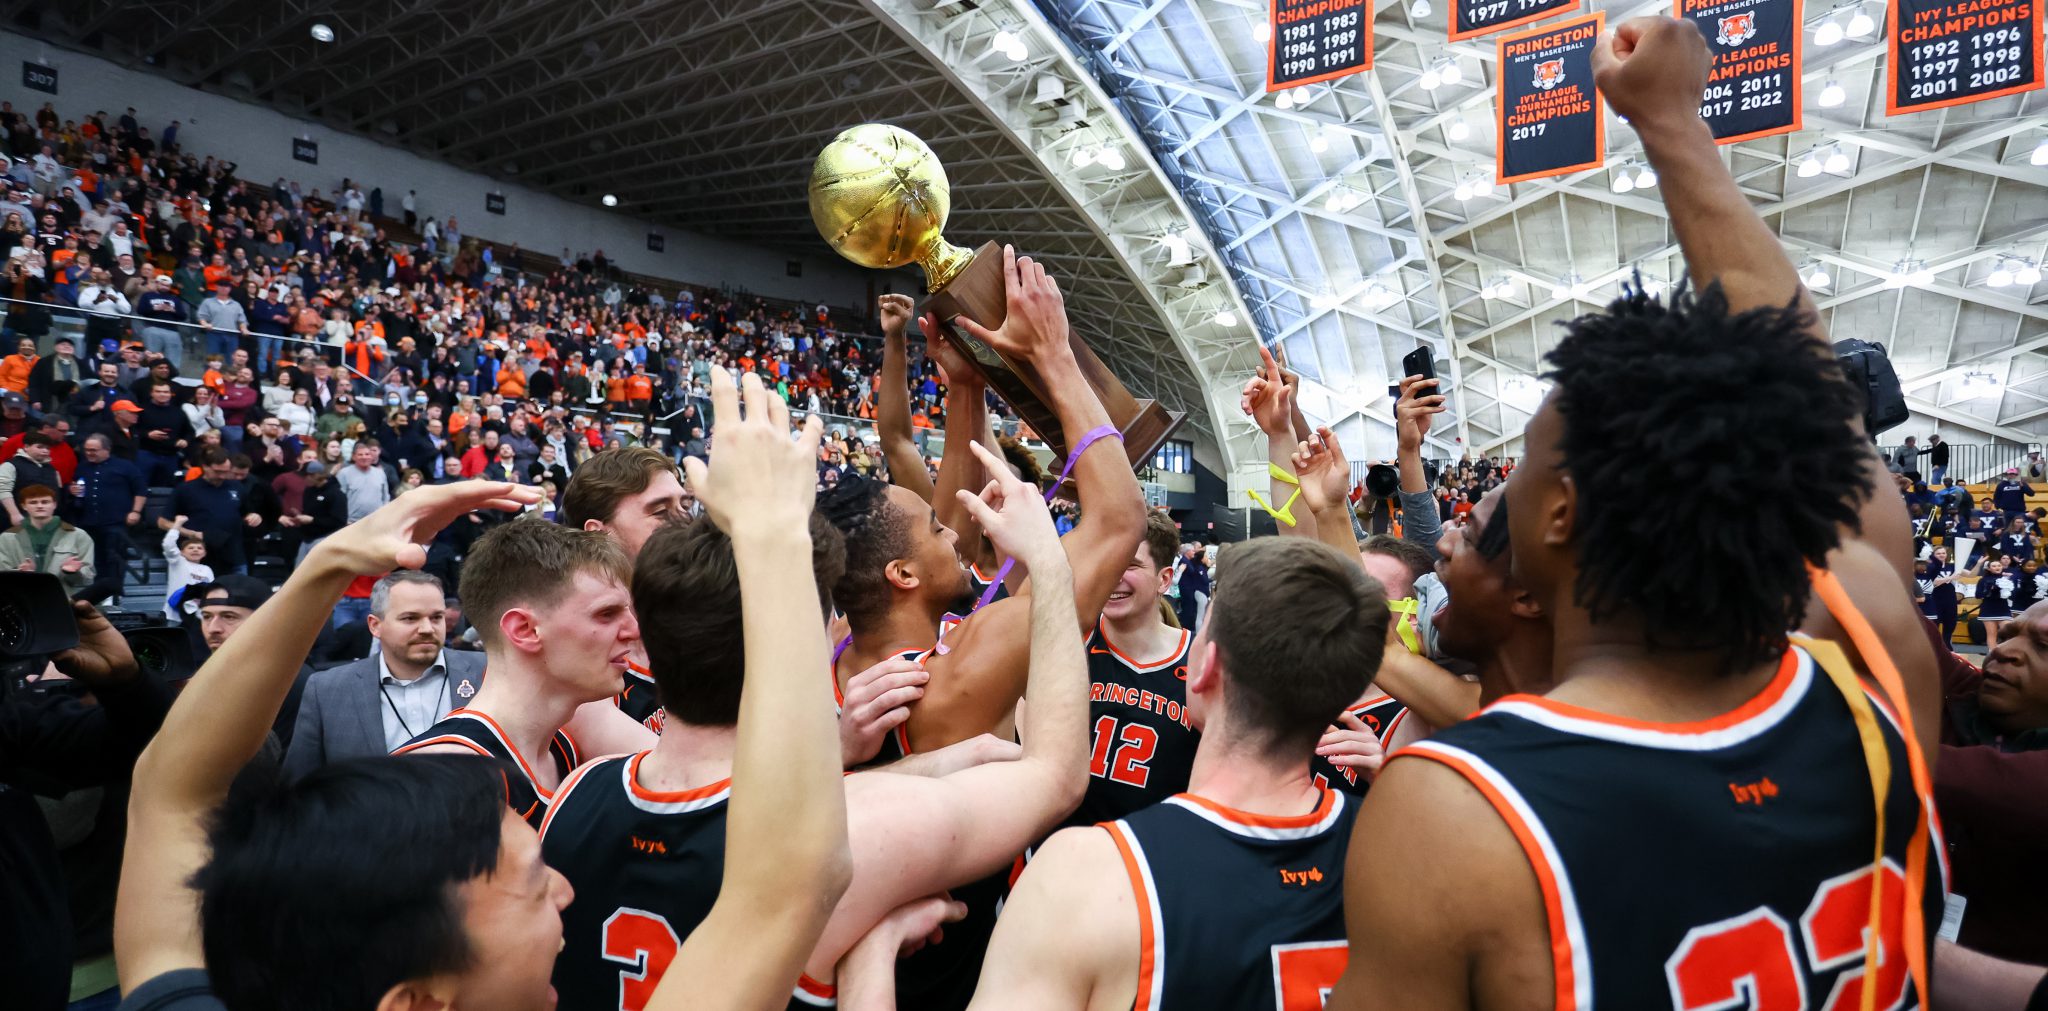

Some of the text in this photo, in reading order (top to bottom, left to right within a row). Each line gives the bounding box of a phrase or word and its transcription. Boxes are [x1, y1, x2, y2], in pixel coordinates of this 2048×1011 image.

[1468, 1, 1508, 23] 1977
[1696, 6, 1721, 18] MEN'S
[1723, 0, 1771, 12] BASKETB
[1915, 8, 1942, 24] IVY
[1283, 12, 1358, 41] 1981 1983
[1901, 4, 2031, 44] CHAMPIONS
[1283, 29, 1357, 58] 1984 1989
[1506, 25, 1594, 57] PRINCETON
[1514, 41, 1585, 64] MEN'S BASKETBALL
[1722, 42, 1778, 64] LEAGUE
[1911, 26, 2021, 62] 1992 1996
[1282, 47, 1355, 76] 1990 1991
[1708, 53, 1791, 82] AMPIONS
[1911, 46, 2021, 80] 1997 1998
[30, 71, 55, 87] 307
[1703, 74, 1781, 101] 004 2011
[1910, 65, 2021, 99] 2001 2002
[1515, 92, 1583, 113] TOURNAMENT
[1520, 84, 1578, 104] IVY LEAGUE
[1741, 91, 1783, 111] 2022
[1507, 100, 1591, 127] CHAMPIONS
[1512, 122, 1546, 141] 2017
[1979, 516, 1996, 528] Y
[1089, 682, 1193, 732] RINCETON
[1090, 714, 1159, 789] 12
[631, 834, 655, 854] Ivy
[1279, 869, 1308, 887] Ivy
